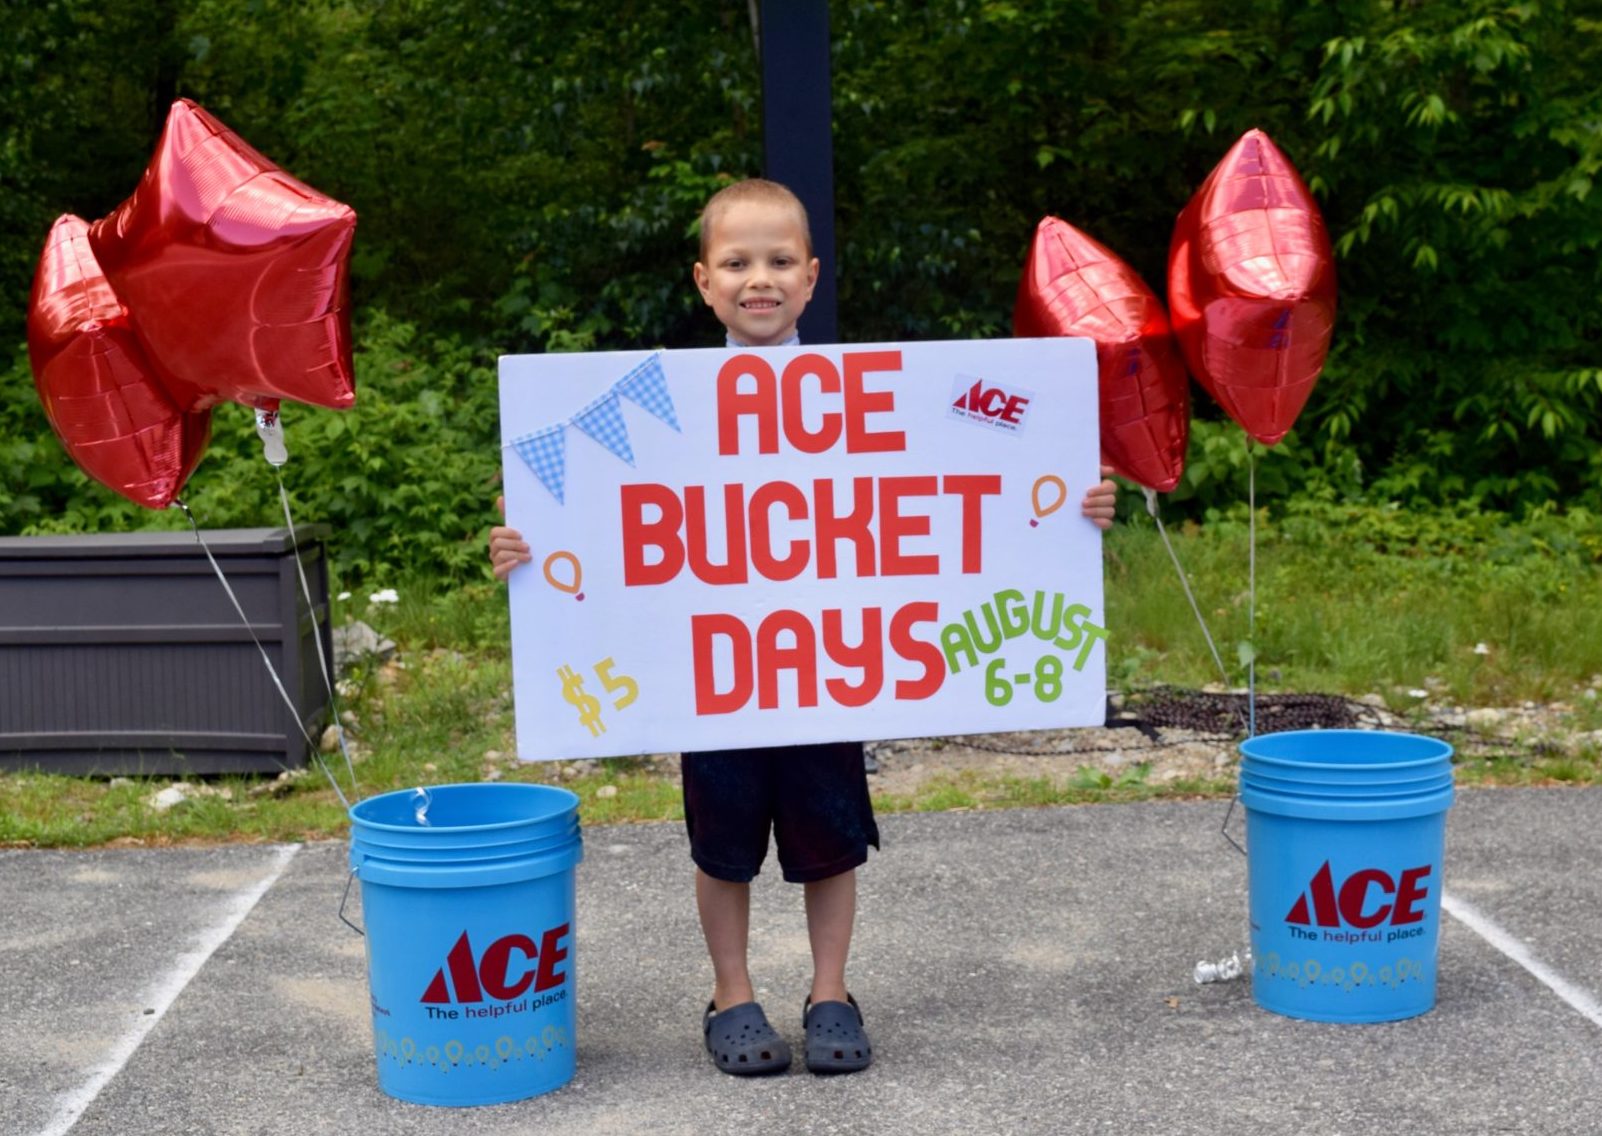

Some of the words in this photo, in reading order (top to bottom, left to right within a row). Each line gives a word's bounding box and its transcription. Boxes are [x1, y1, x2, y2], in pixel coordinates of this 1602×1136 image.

[717, 350, 906, 456] ACE
[952, 378, 1029, 424] ACE
[620, 474, 1002, 587] BUCKET
[691, 601, 946, 716] DAYS
[940, 589, 1110, 674] AUGUST
[556, 657, 639, 738] $5
[985, 655, 1063, 707] 6-8
[1284, 859, 1431, 929] ACE
[419, 922, 570, 1004] ACE
[1287, 925, 1318, 941] The
[1323, 929, 1383, 945] helpful
[425, 1006, 459, 1020] The
[465, 999, 527, 1019] helpful
